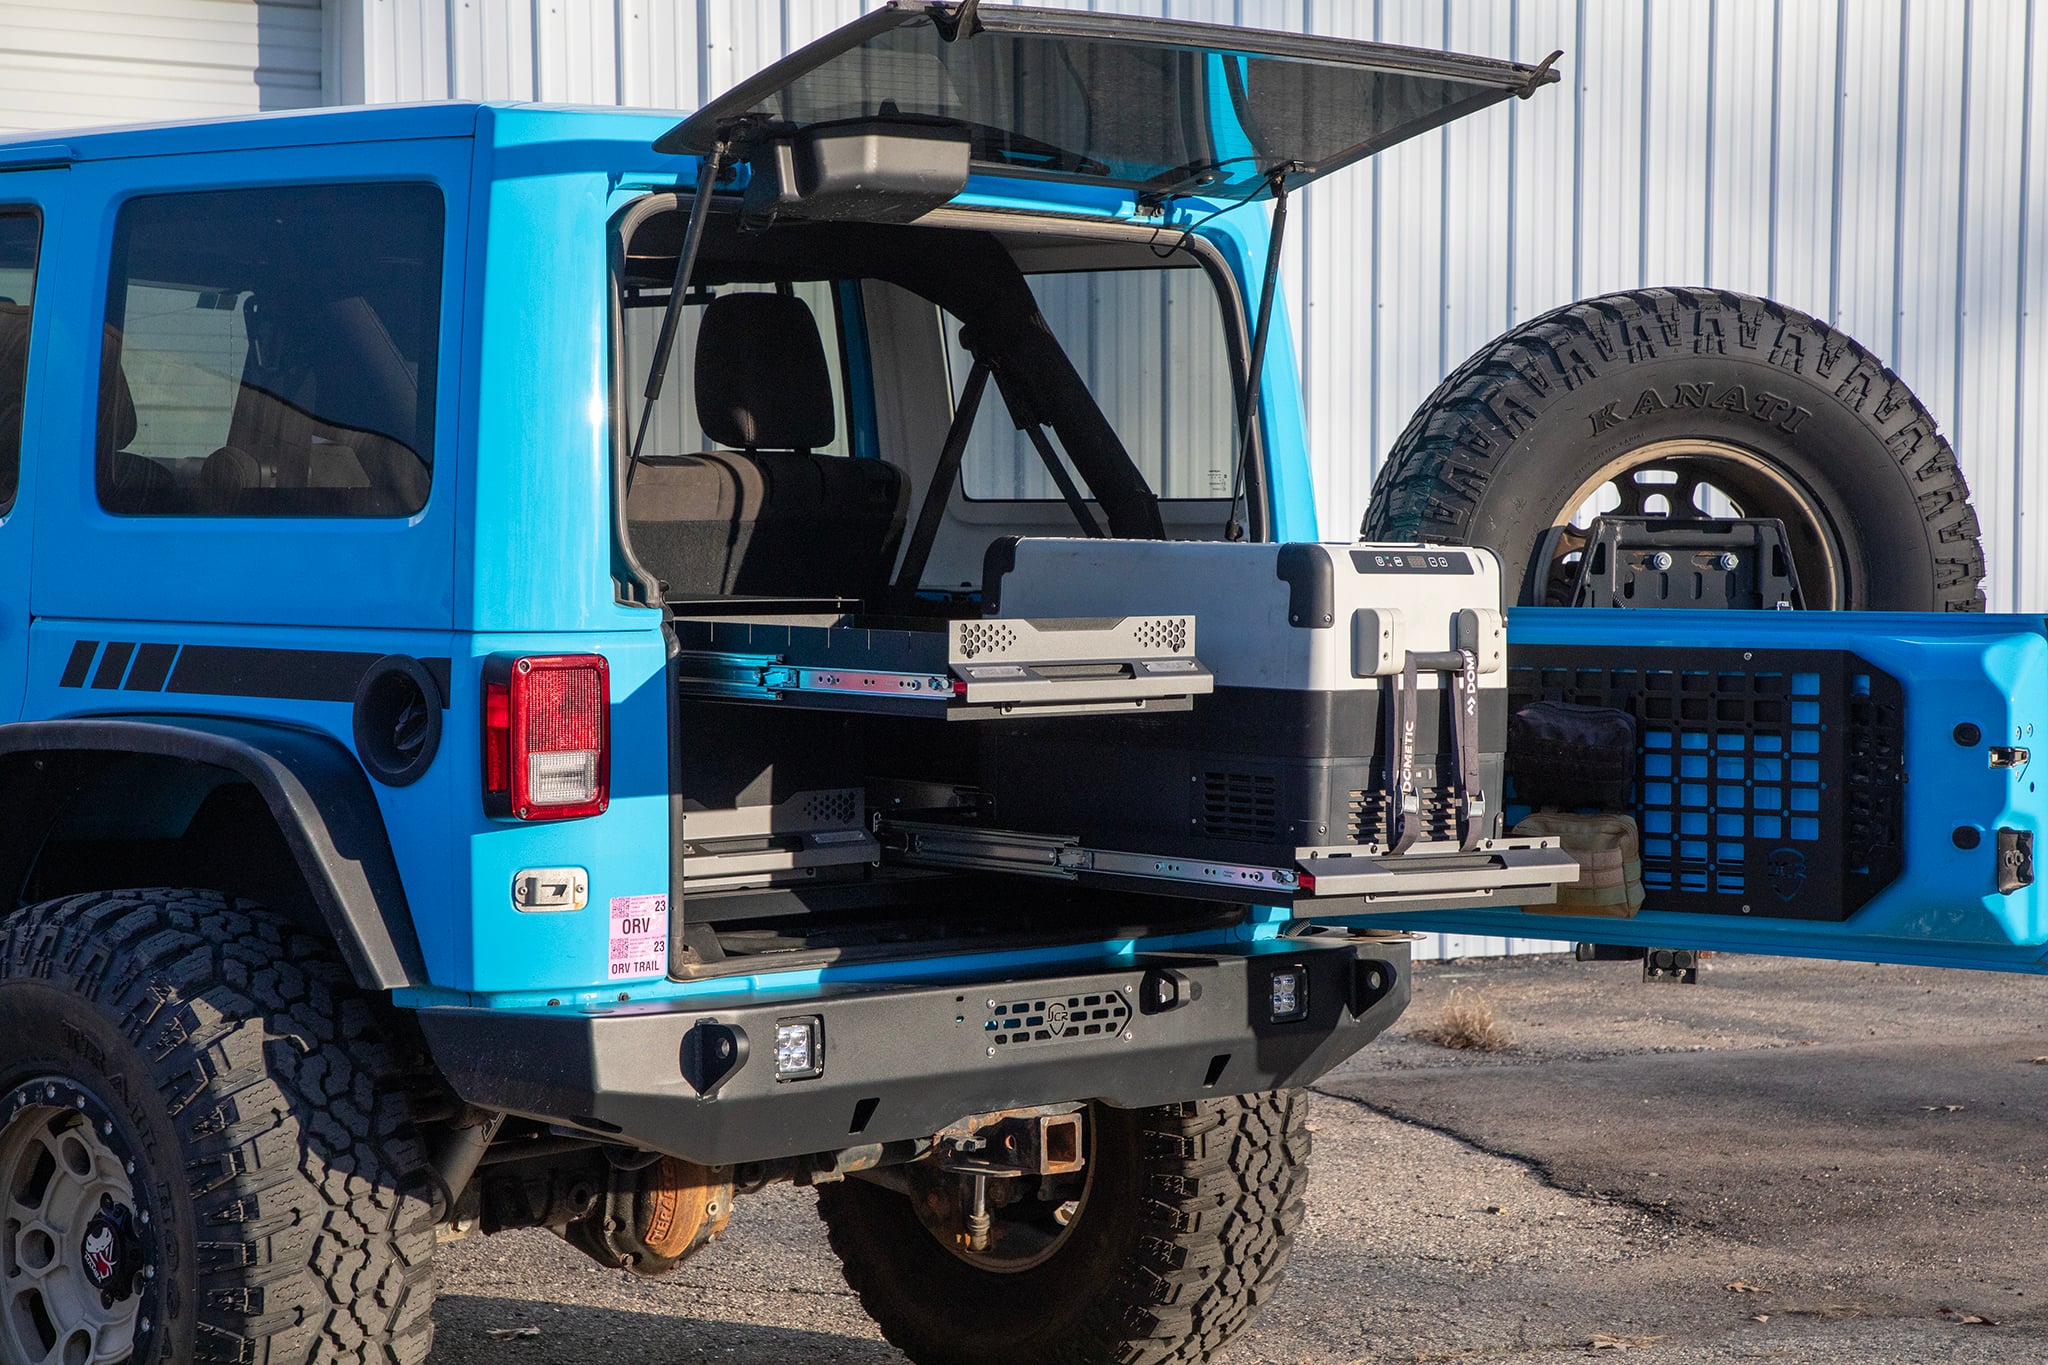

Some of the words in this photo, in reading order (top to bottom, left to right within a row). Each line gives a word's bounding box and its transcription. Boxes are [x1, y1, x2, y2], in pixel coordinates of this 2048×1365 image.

[1589, 381, 1813, 436] KANATI
[1402, 720, 1414, 793] DOMETIC
[655, 900, 666, 912] 23
[622, 917, 650, 935] ORV
[653, 941, 665, 952] 23
[611, 962, 630, 974] ORV
[634, 960, 659, 972] TRAIL
[1047, 1011, 1068, 1022] JCR
